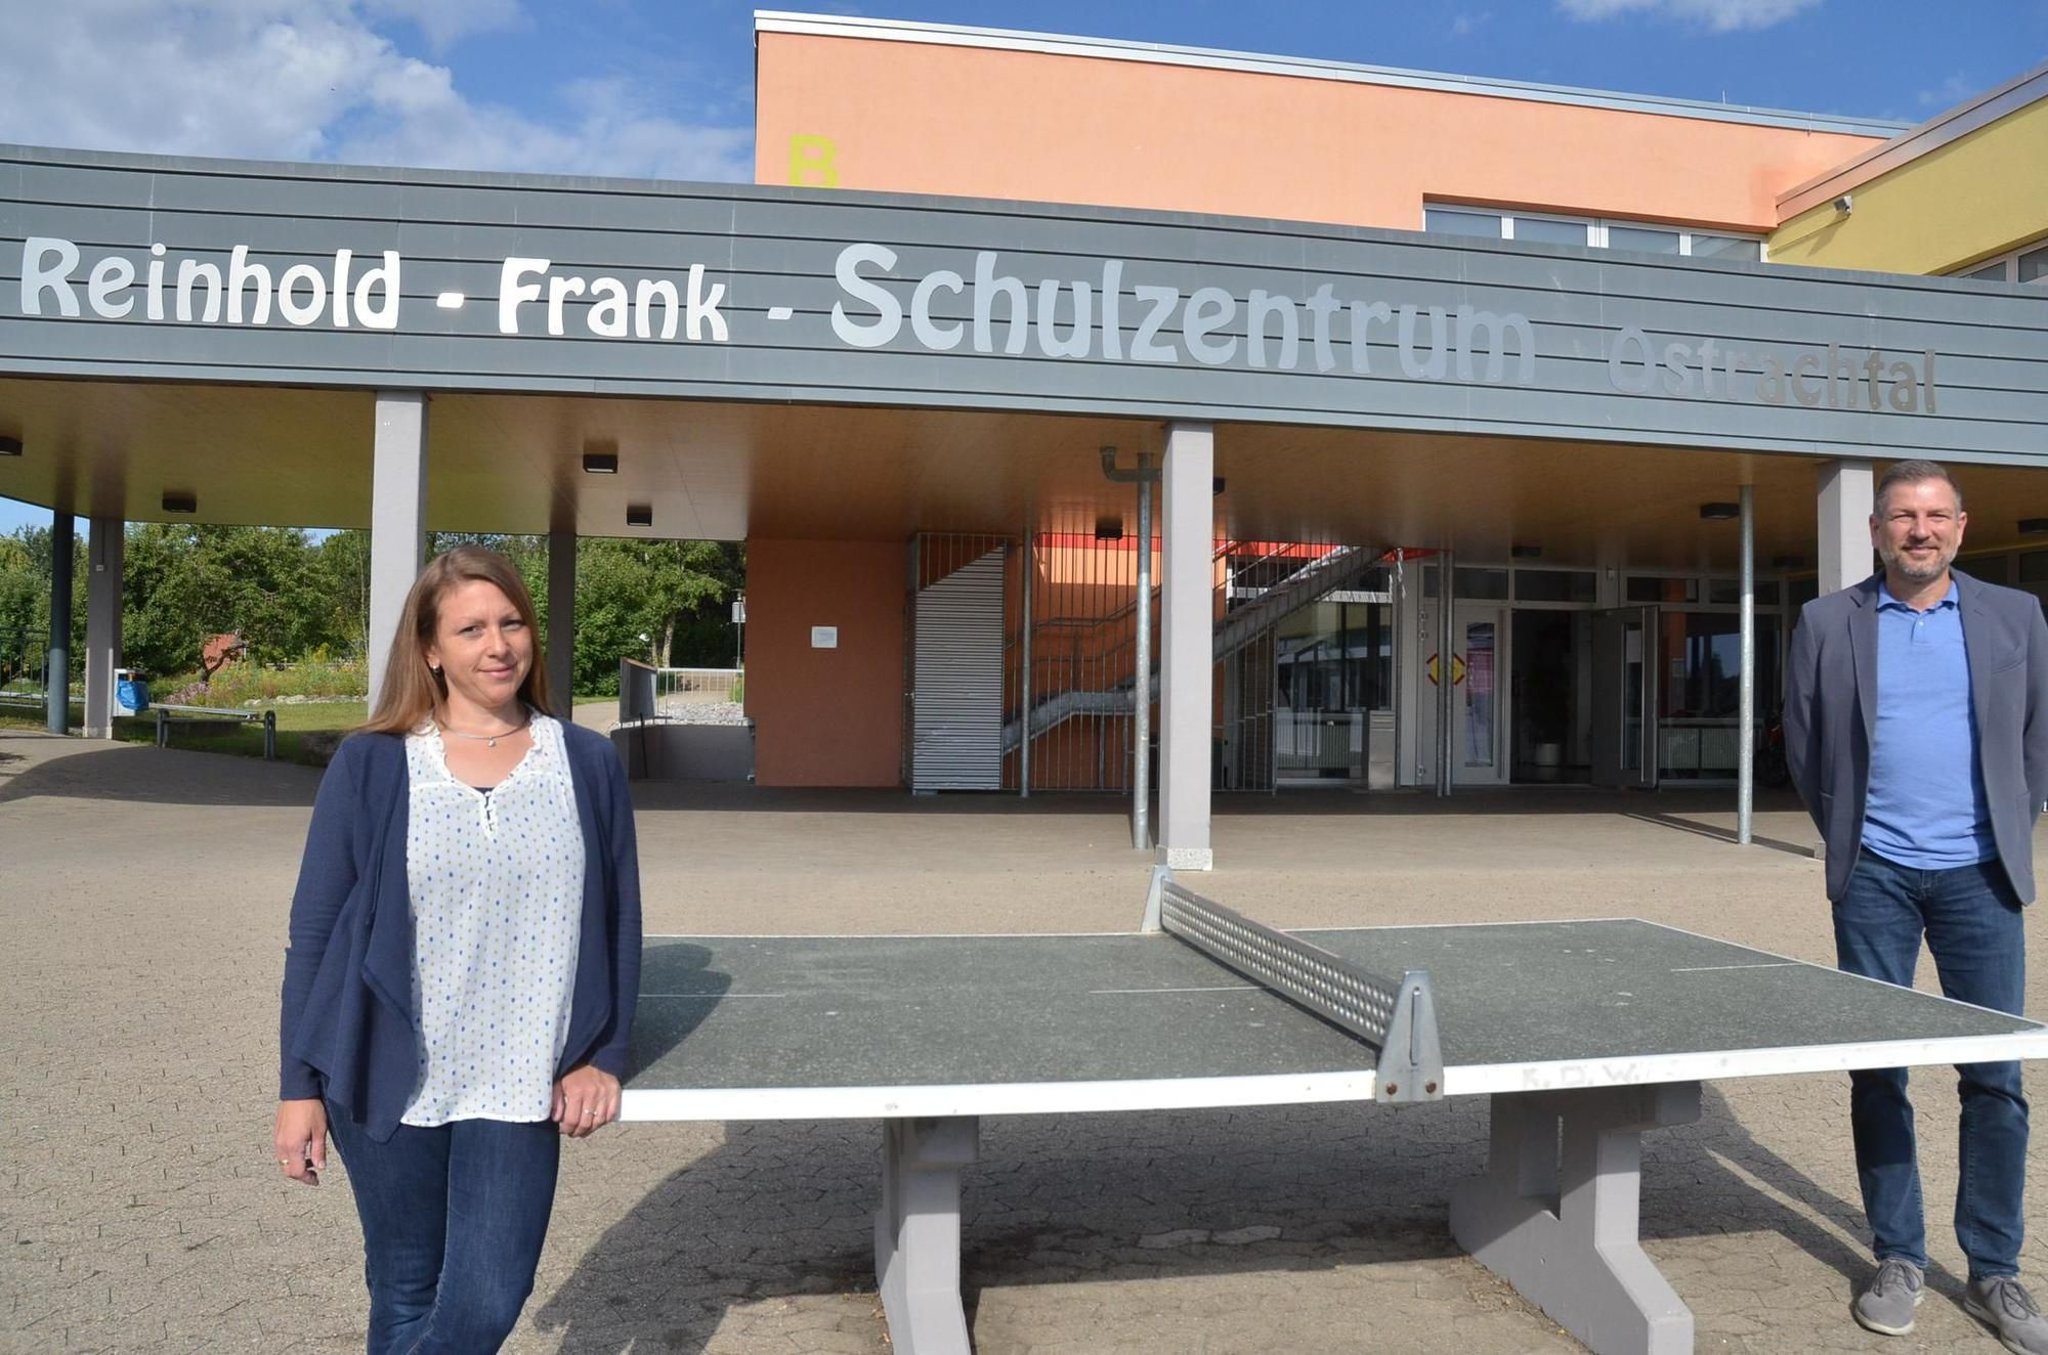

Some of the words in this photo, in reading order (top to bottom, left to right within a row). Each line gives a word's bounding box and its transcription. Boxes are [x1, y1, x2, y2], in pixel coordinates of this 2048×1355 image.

[789, 134, 837, 188] B
[20, 236, 401, 329] Reinhold
[499, 257, 729, 341] Frank
[831, 243, 1536, 384] Schulzentrum
[1608, 325, 1937, 415] Ostrachtal
